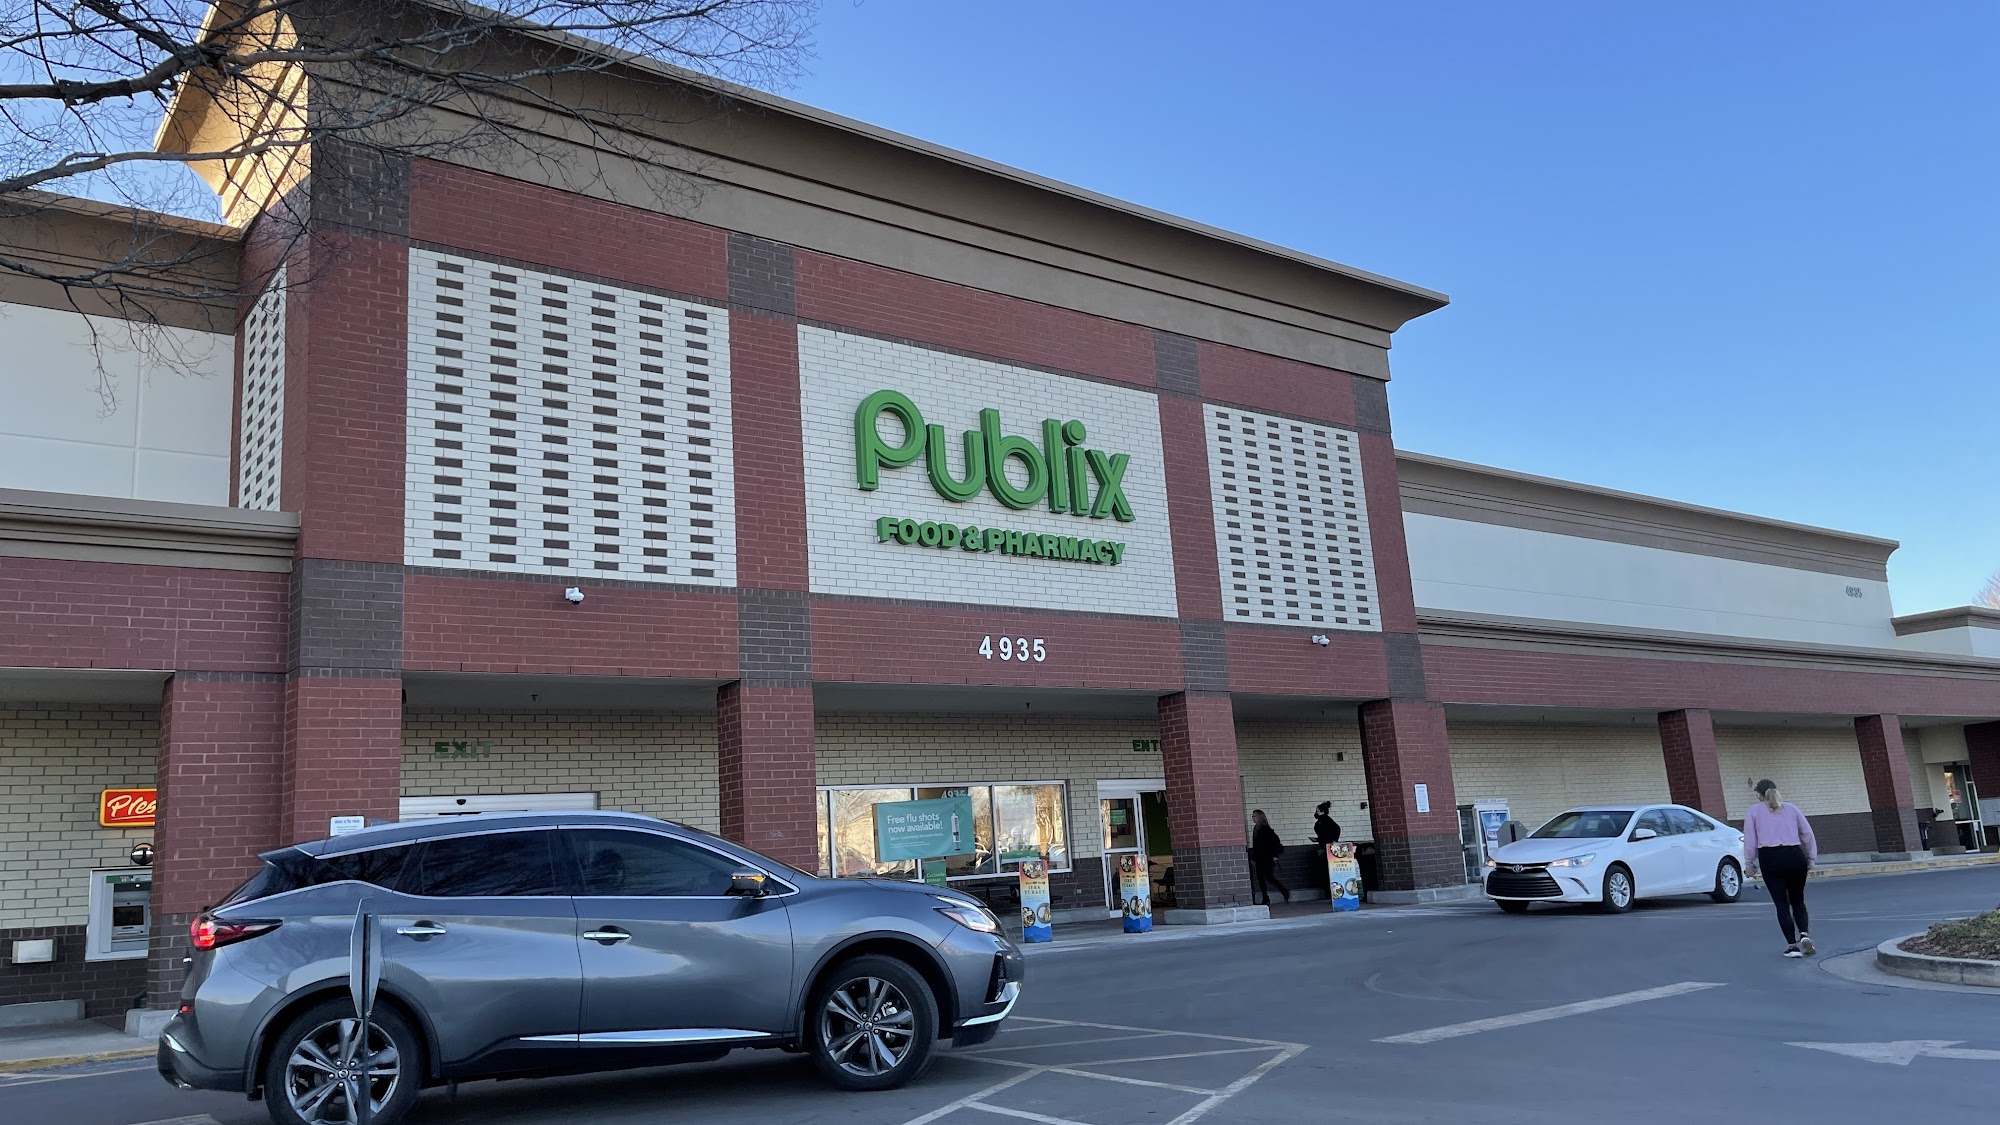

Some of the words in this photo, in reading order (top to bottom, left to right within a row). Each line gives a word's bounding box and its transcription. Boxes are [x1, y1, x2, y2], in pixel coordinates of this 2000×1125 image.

[854, 389, 1136, 522] Publix
[876, 516, 960, 548] FOOD
[960, 525, 983, 553] &
[983, 527, 1126, 566] PHARMACY
[978, 635, 1047, 662] 4935
[434, 740, 494, 759] EXIT
[1132, 739, 1162, 752] ENT
[887, 815, 905, 825] Free
[906, 813, 917, 823] flu
[888, 826, 905, 834] now
[906, 821, 943, 832] available!
